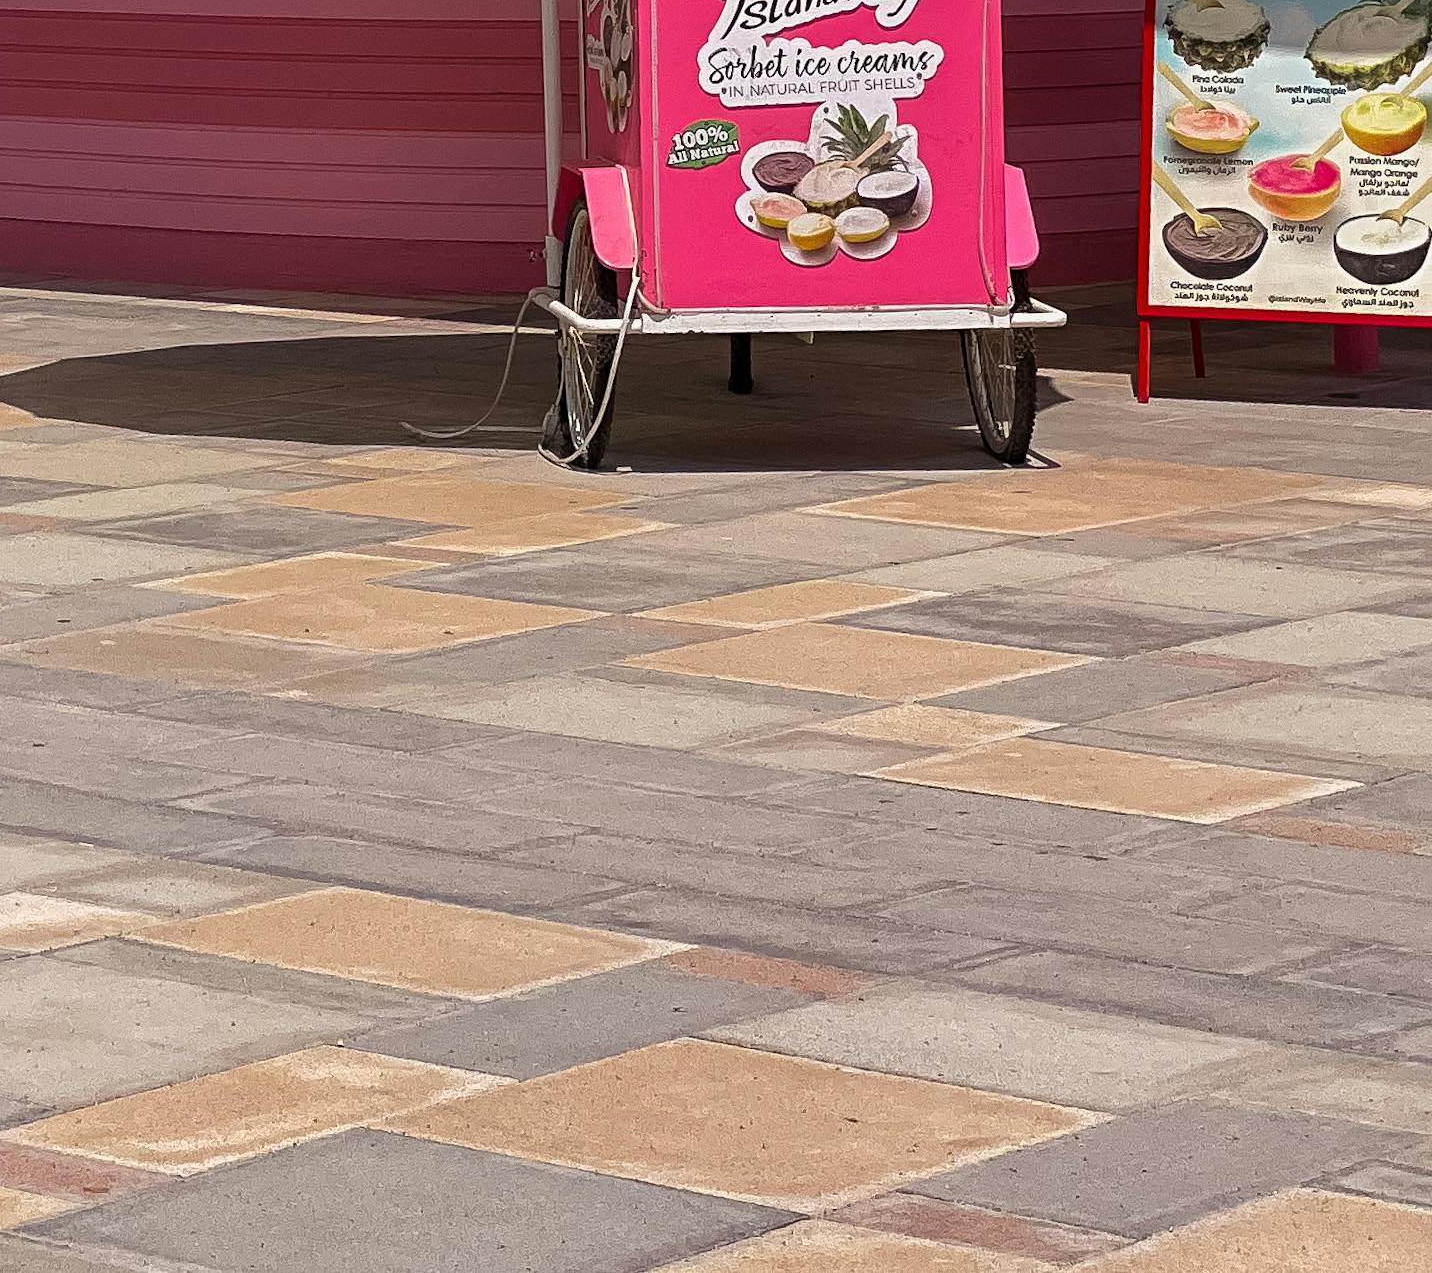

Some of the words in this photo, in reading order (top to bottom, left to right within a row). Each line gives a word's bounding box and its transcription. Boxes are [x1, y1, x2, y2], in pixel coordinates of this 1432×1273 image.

[709, 45, 789, 84] Sorbet
[796, 49, 831, 77] ice
[838, 50, 934, 74] creams
[729, 86, 744, 97] IN
[750, 84, 815, 97] NATURAL
[820, 80, 860, 93] FRUIT
[865, 76, 915, 91] SHELLS
[1276, 85, 1302, 94] Sweet
[1303, 85, 1347, 96] Pineapple
[672, 125, 729, 151] 100%
[668, 150, 688, 165] All
[689, 141, 740, 160] Natural
[1224, 157, 1254, 166] Lemon
[1350, 168, 1382, 178] Mango
[1384, 169, 1418, 179] Orange
[1272, 223, 1296, 234] Ruby
[1299, 224, 1323, 235] Berry
[1170, 281, 1215, 291] Chocolate
[1216, 283, 1253, 293] Coconut
[1336, 286, 1378, 297] Heavenly
[1381, 287, 1419, 298] Coconut
